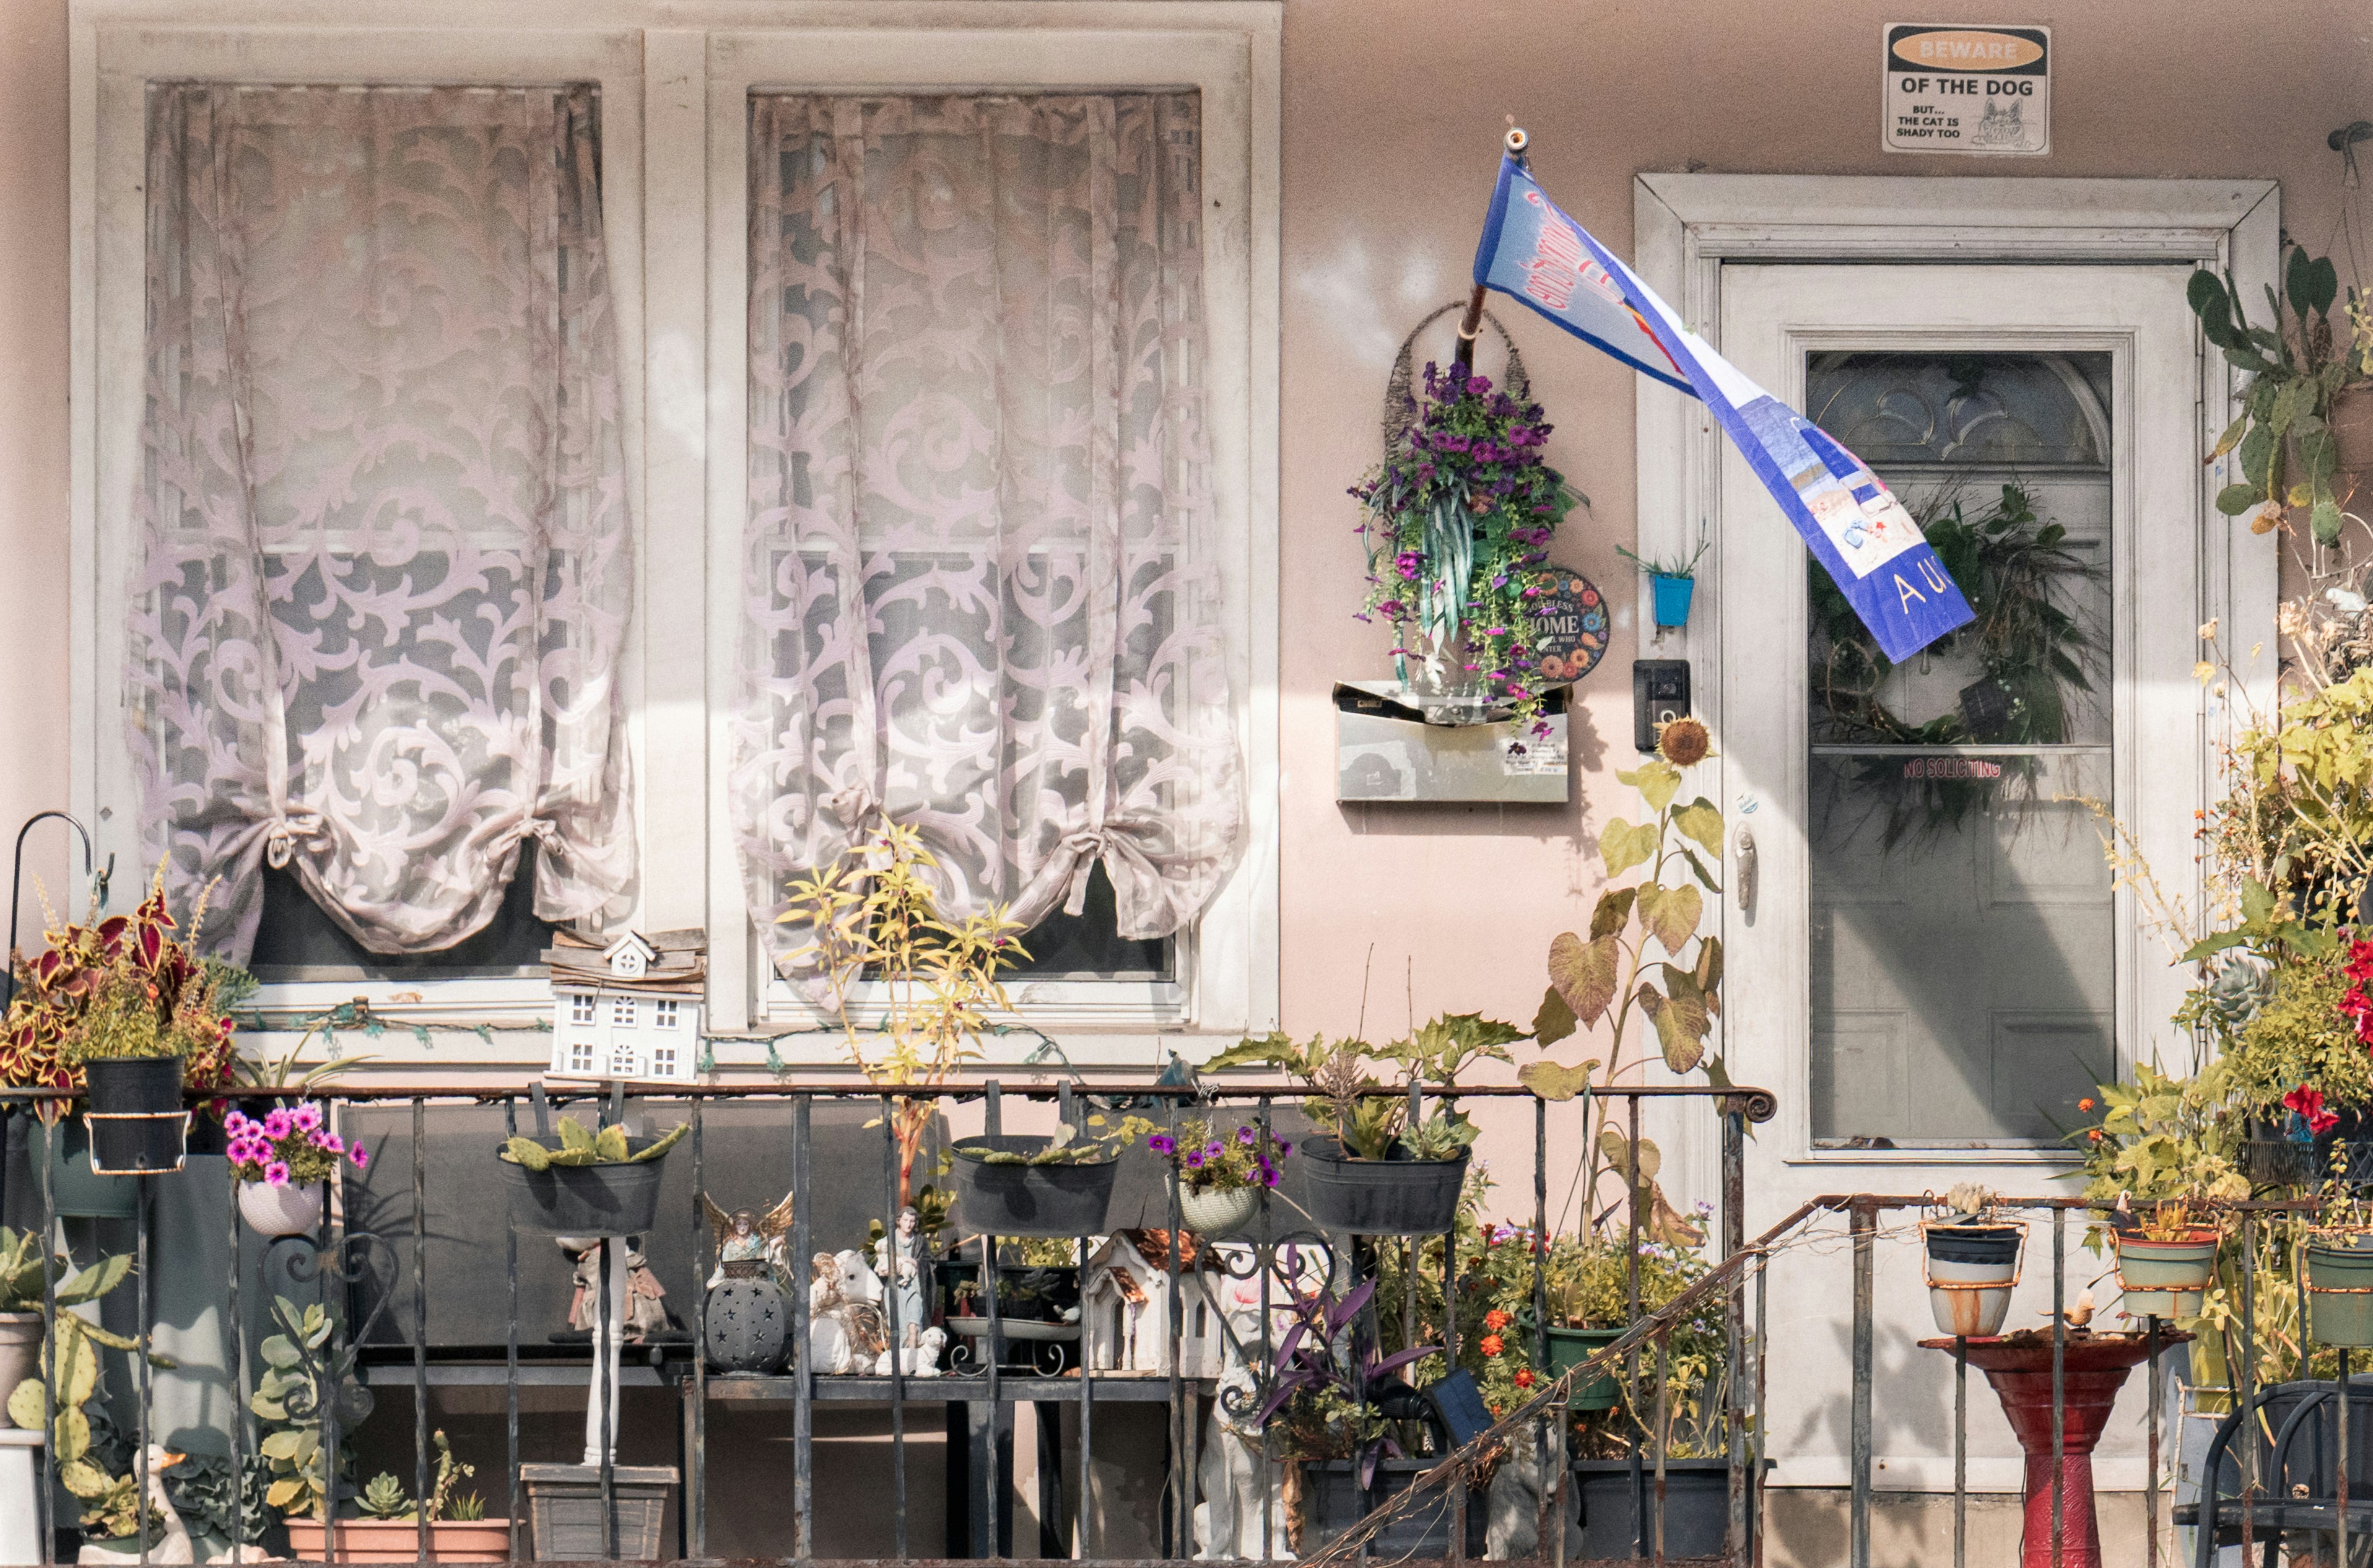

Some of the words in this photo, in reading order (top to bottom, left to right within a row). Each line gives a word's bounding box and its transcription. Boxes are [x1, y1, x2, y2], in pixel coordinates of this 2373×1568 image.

[1920, 40, 2018, 60] BEWARE
[1901, 77, 1930, 94] OF
[1936, 79, 1979, 95] THE
[1986, 80, 2033, 96] DOG
[1913, 105, 1944, 115] BUT...
[1898, 116, 1919, 125] THE
[1922, 117, 1944, 126] CAT
[1947, 118, 1959, 126] IS
[1896, 128, 1934, 137] SHADY
[1937, 129, 1961, 138] TOO
[1546, 599, 1574, 612] BLESS
[1904, 758, 1924, 778] NO
[1927, 757, 2001, 778] SOLICITING
